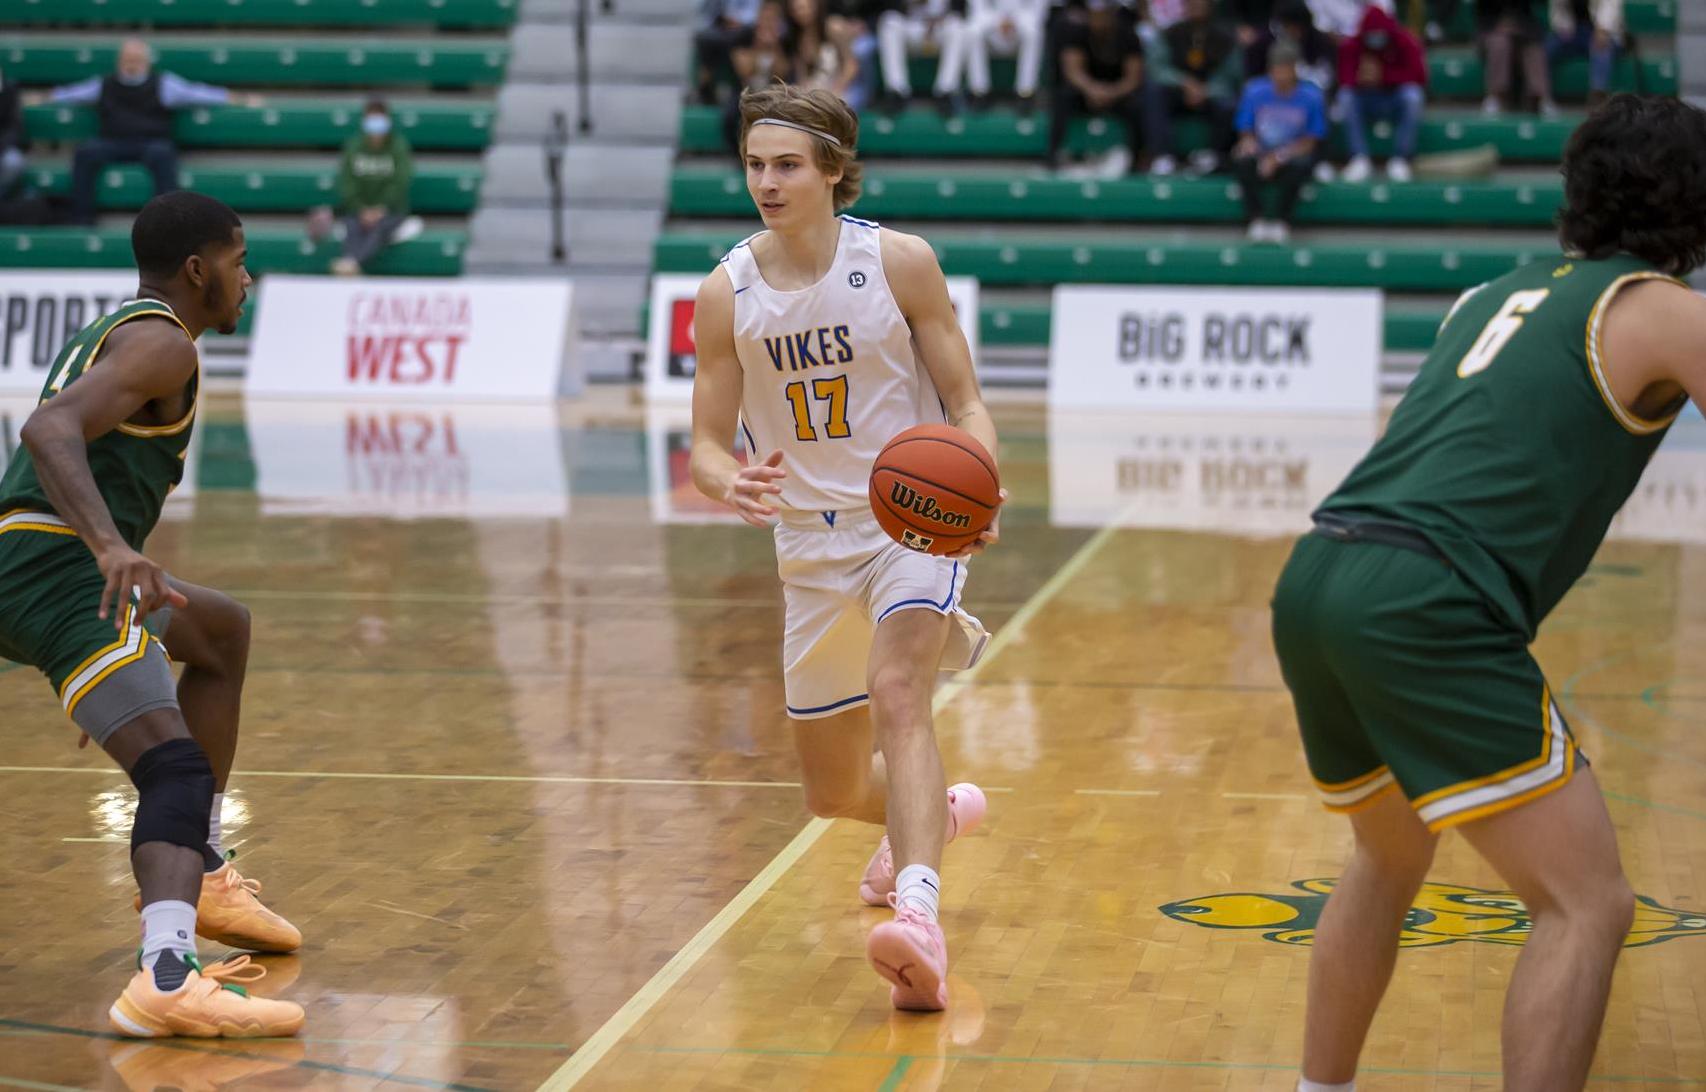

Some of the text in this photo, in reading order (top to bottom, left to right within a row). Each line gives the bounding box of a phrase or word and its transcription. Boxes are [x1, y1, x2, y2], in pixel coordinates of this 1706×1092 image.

[347, 335, 471, 382] WEST
[763, 324, 854, 372] VIKES
[1202, 312, 1312, 366] ROCK
[1457, 287, 1550, 379] 6
[785, 374, 851, 442] 17
[889, 480, 972, 528] Wilson
